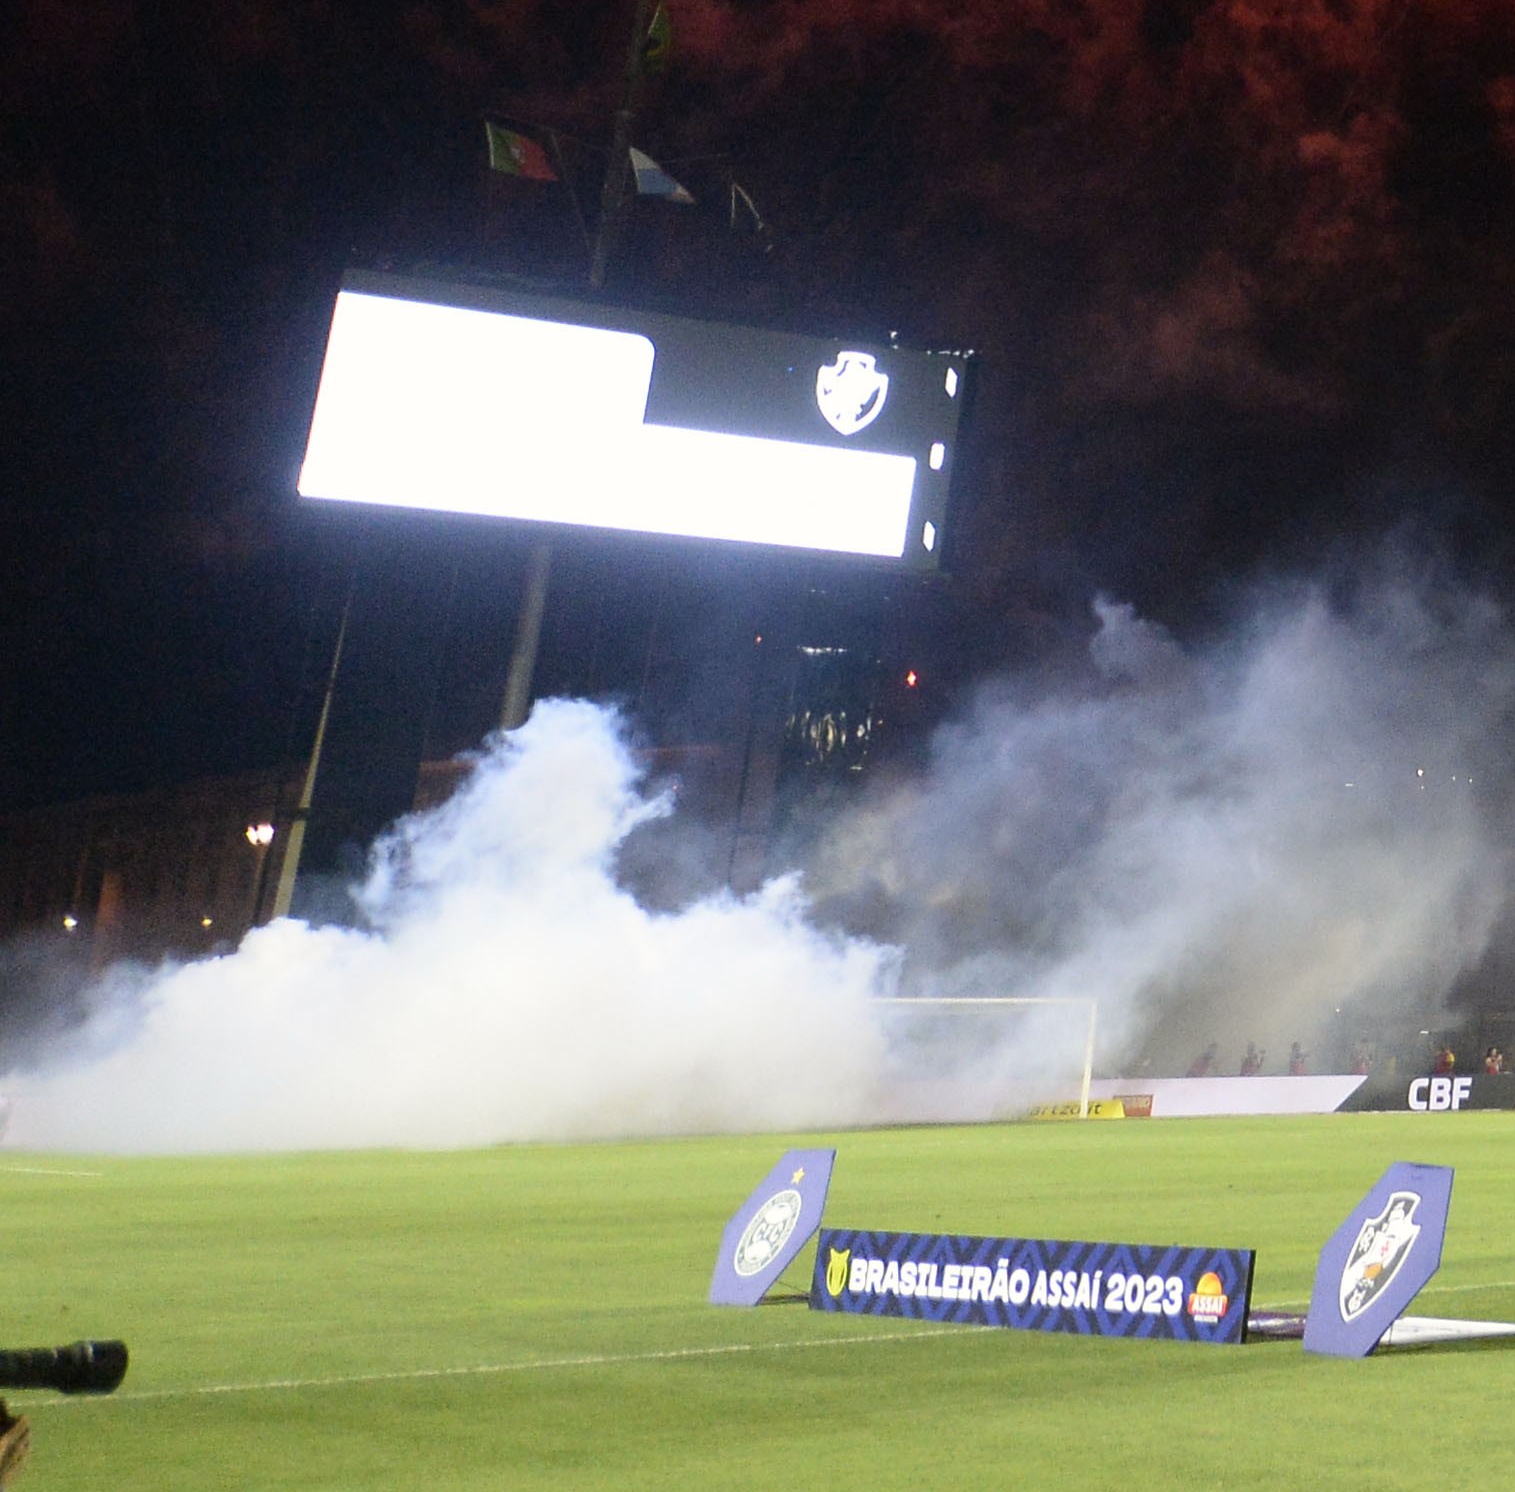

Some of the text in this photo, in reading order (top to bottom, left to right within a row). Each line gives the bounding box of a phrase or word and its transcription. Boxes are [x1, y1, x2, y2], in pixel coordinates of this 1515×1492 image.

[1408, 1077, 1473, 1110] CBF
[848, 1257, 1184, 1314] BRASILEIRÃO ASSAÍ 2023
